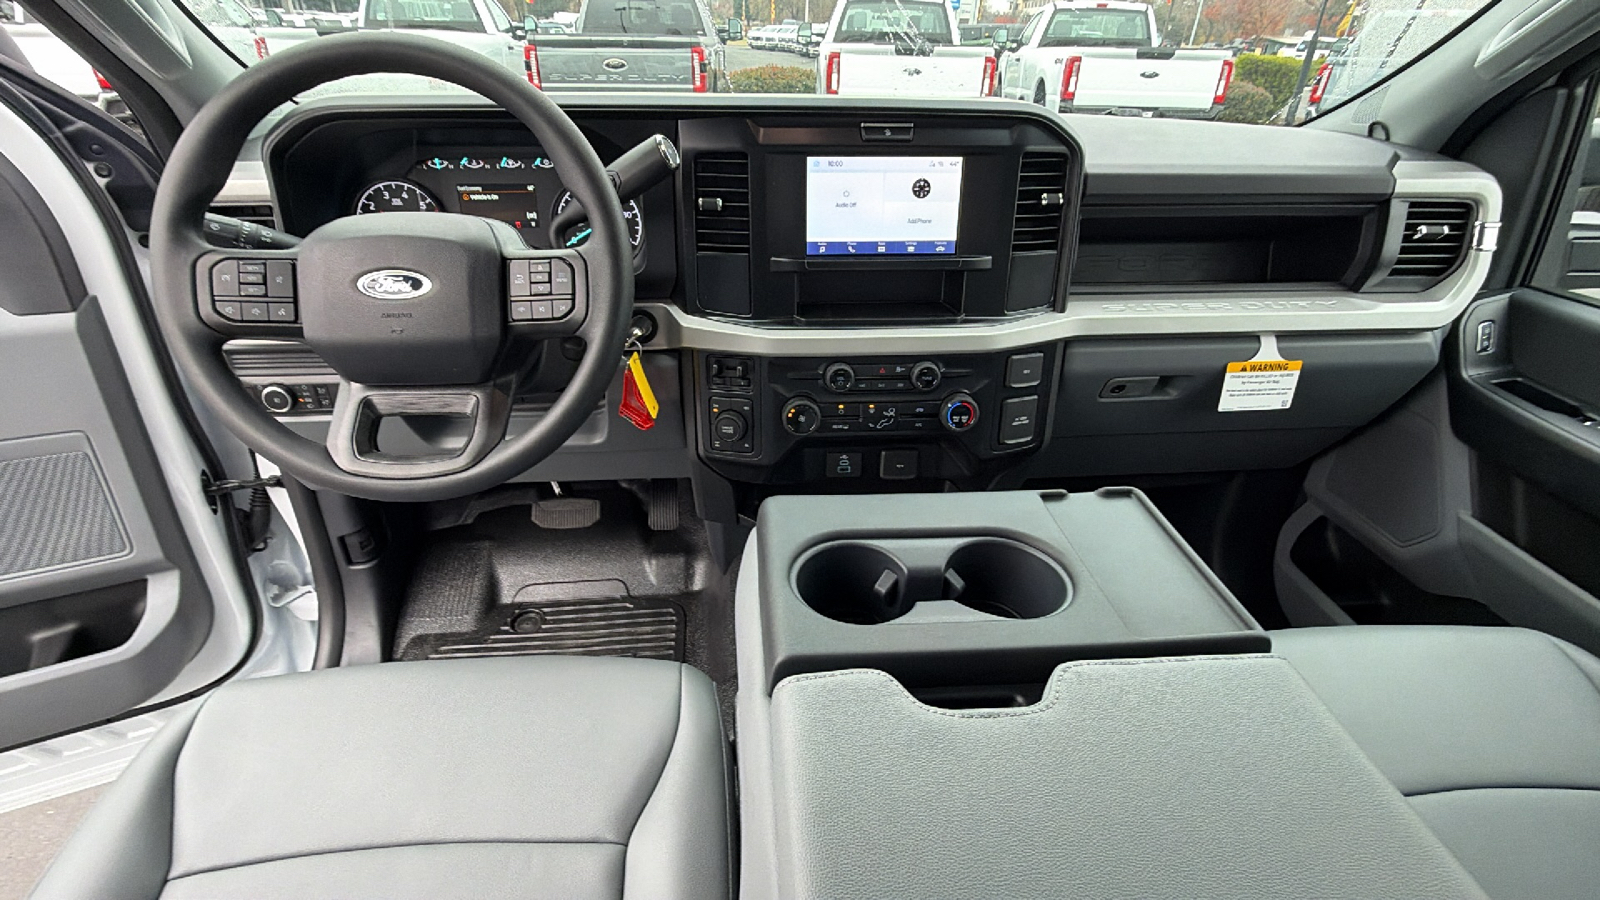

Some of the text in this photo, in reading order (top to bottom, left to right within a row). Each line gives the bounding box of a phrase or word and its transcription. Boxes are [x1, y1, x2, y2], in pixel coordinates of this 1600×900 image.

[383, 191, 390, 200] 3
[401, 191, 408, 199] 4
[368, 201, 376, 210] 2
[419, 201, 427, 210] 5
[1101, 300, 1337, 312] SUPER DUTY
[1249, 363, 1289, 372] WARNING
